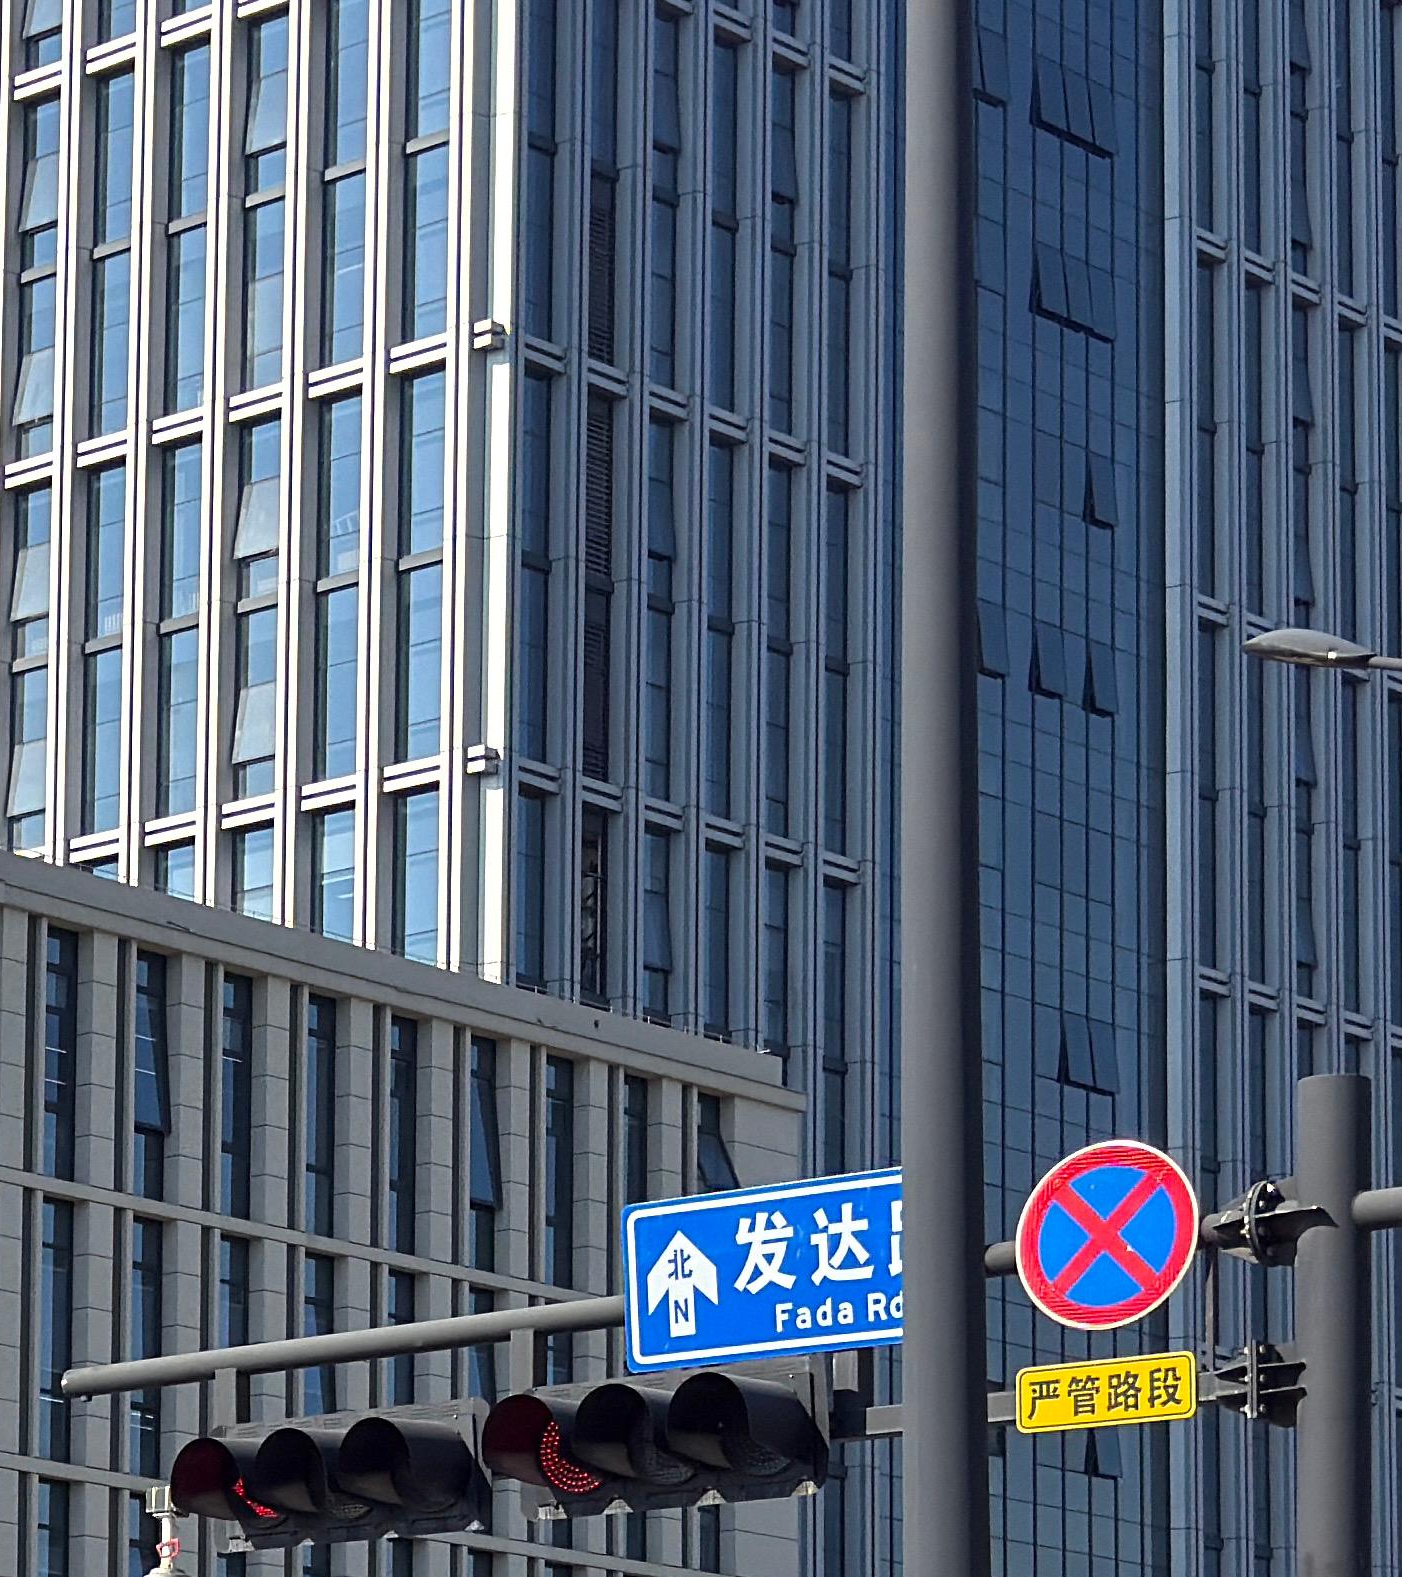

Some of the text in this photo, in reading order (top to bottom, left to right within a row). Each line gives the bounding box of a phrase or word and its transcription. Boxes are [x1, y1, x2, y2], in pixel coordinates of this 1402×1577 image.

[667, 1248, 694, 1281] 北
[733, 1200, 903, 1296] 发达
[673, 1297, 690, 1324] N
[774, 1297, 855, 1333] Fada
[1027, 1366, 1184, 1422] 严管路段
